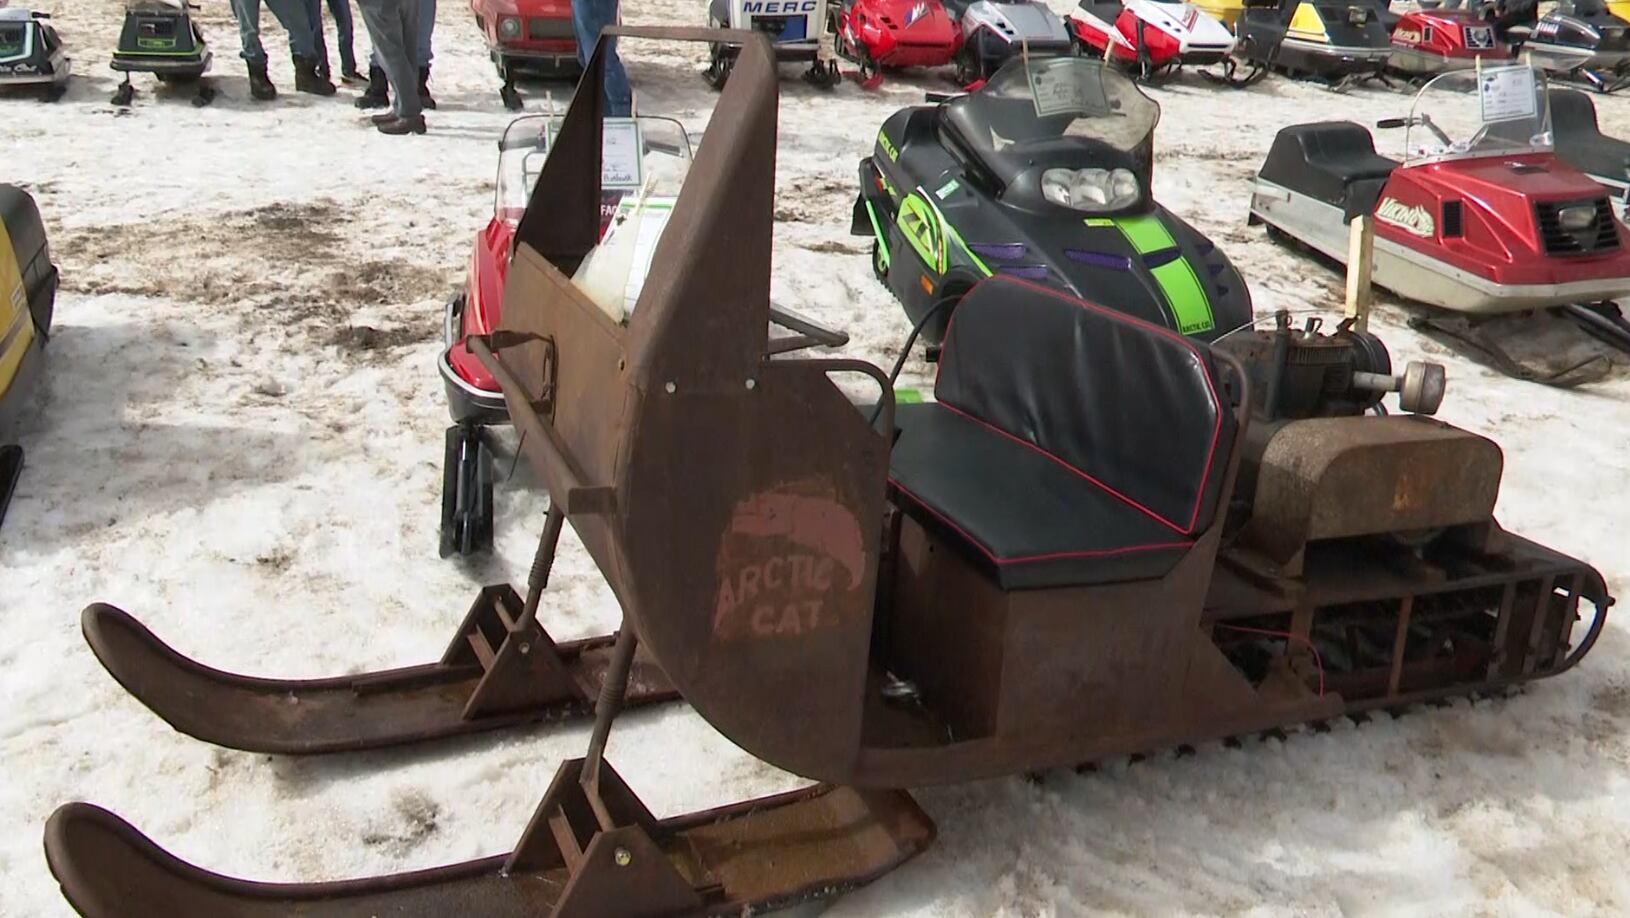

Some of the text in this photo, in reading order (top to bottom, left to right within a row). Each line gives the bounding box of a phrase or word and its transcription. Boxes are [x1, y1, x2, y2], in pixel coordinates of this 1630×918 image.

[743, 1, 817, 13] MERC
[714, 556, 834, 636] ARCTIC
[752, 600, 824, 634] CAT
